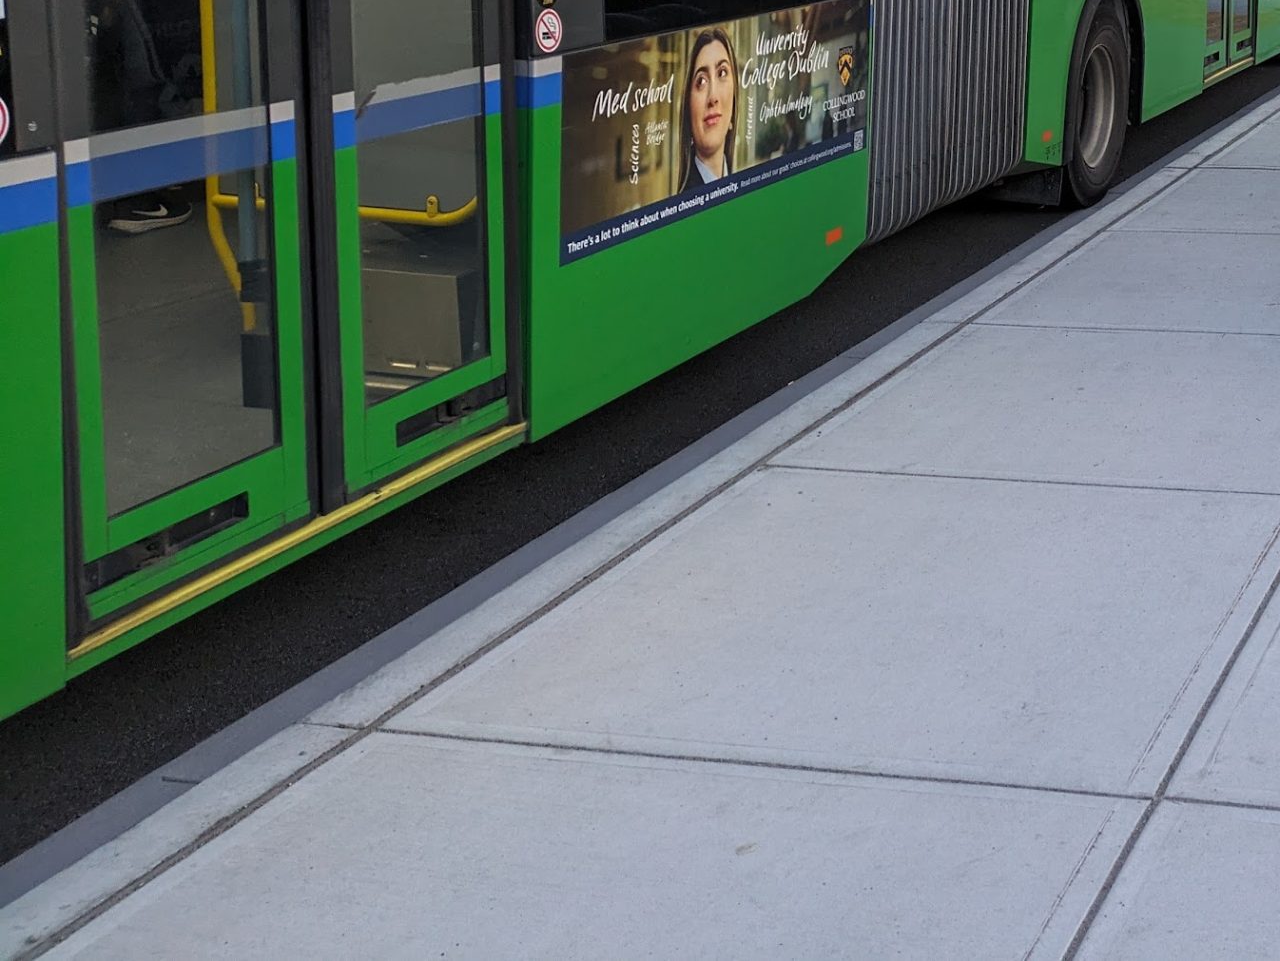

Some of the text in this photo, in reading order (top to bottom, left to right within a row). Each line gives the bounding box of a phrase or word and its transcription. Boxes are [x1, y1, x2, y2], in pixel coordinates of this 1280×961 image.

[756, 24, 809, 56] University
[741, 40, 830, 90] College Dublin
[592, 73, 674, 122] Med school
[759, 91, 813, 124] Ophthalmology
[822, 89, 865, 111] COLLINGWOOD
[832, 106, 855, 122] SCHOOL
[629, 124, 640, 185] Sciences
[740, 178, 751, 188] Read
[567, 234, 594, 254] There's
[594, 235, 600, 244] a
[600, 229, 611, 241] lot
[612, 227, 621, 237] to
[621, 219, 640, 233] think
[639, 212, 660, 226] about
[660, 205, 678, 219] when
[678, 194, 705, 212] choosing
[709, 182, 739, 199] university.
